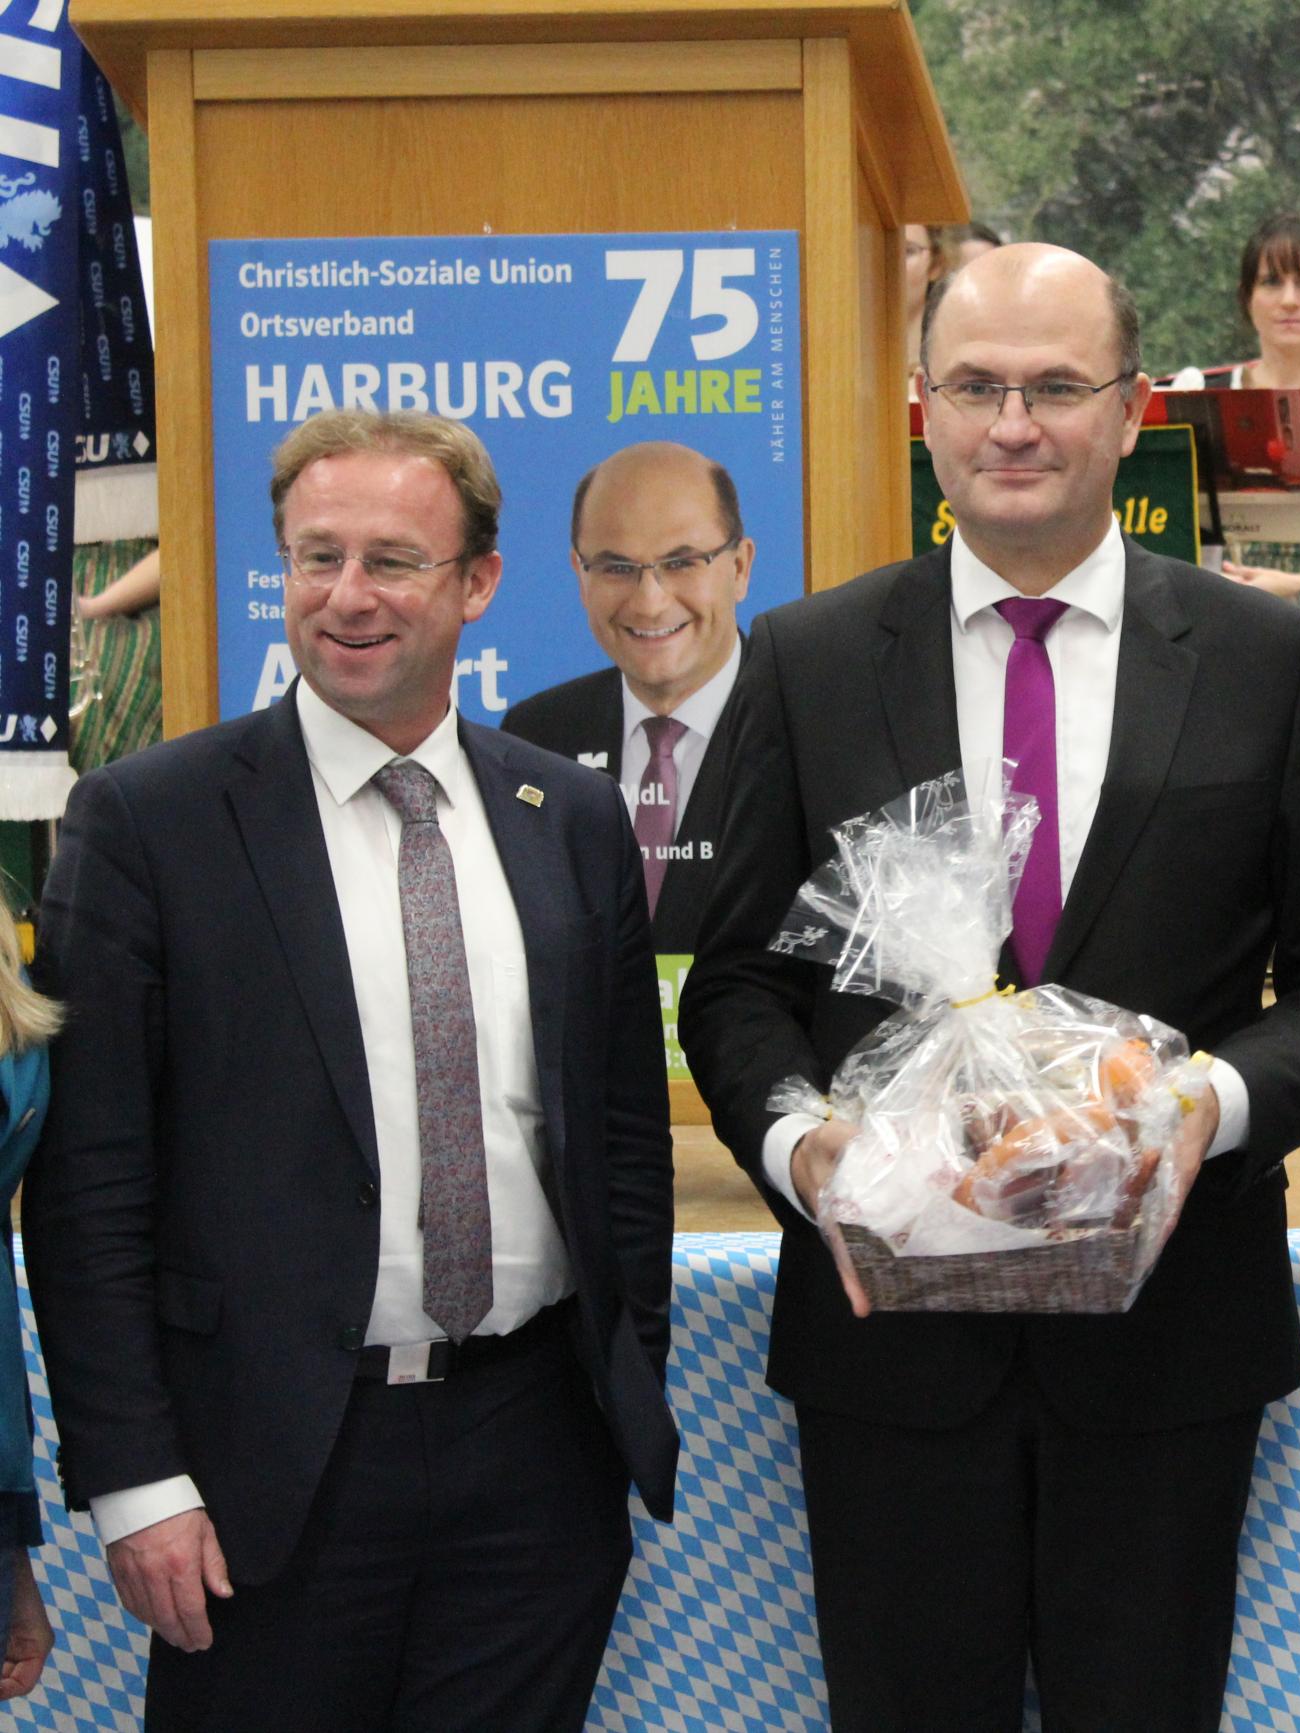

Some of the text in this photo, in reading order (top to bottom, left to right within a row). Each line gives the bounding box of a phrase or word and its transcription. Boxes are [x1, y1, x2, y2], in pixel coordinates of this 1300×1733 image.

[238, 257, 572, 288] Christlich-Soziale Union
[605, 247, 760, 363] 75
[240, 309, 414, 338] Ortsverband
[769, 247, 784, 463] NÄHER AM MENSCHEN
[48, 356, 60, 390] CSU
[245, 360, 573, 422] HARBURG
[606, 368, 763, 424] JAHRE
[19, 393, 31, 427] CSU
[48, 431, 60, 465] CSU
[19, 467, 31, 501] CSU
[46, 505, 59, 539] CSU
[17, 541, 29, 575] CSU
[45, 578, 57, 612] CSU
[16, 615, 28, 649] CSU
[44, 652, 56, 686] CSU
[656, 841, 693, 860] und
